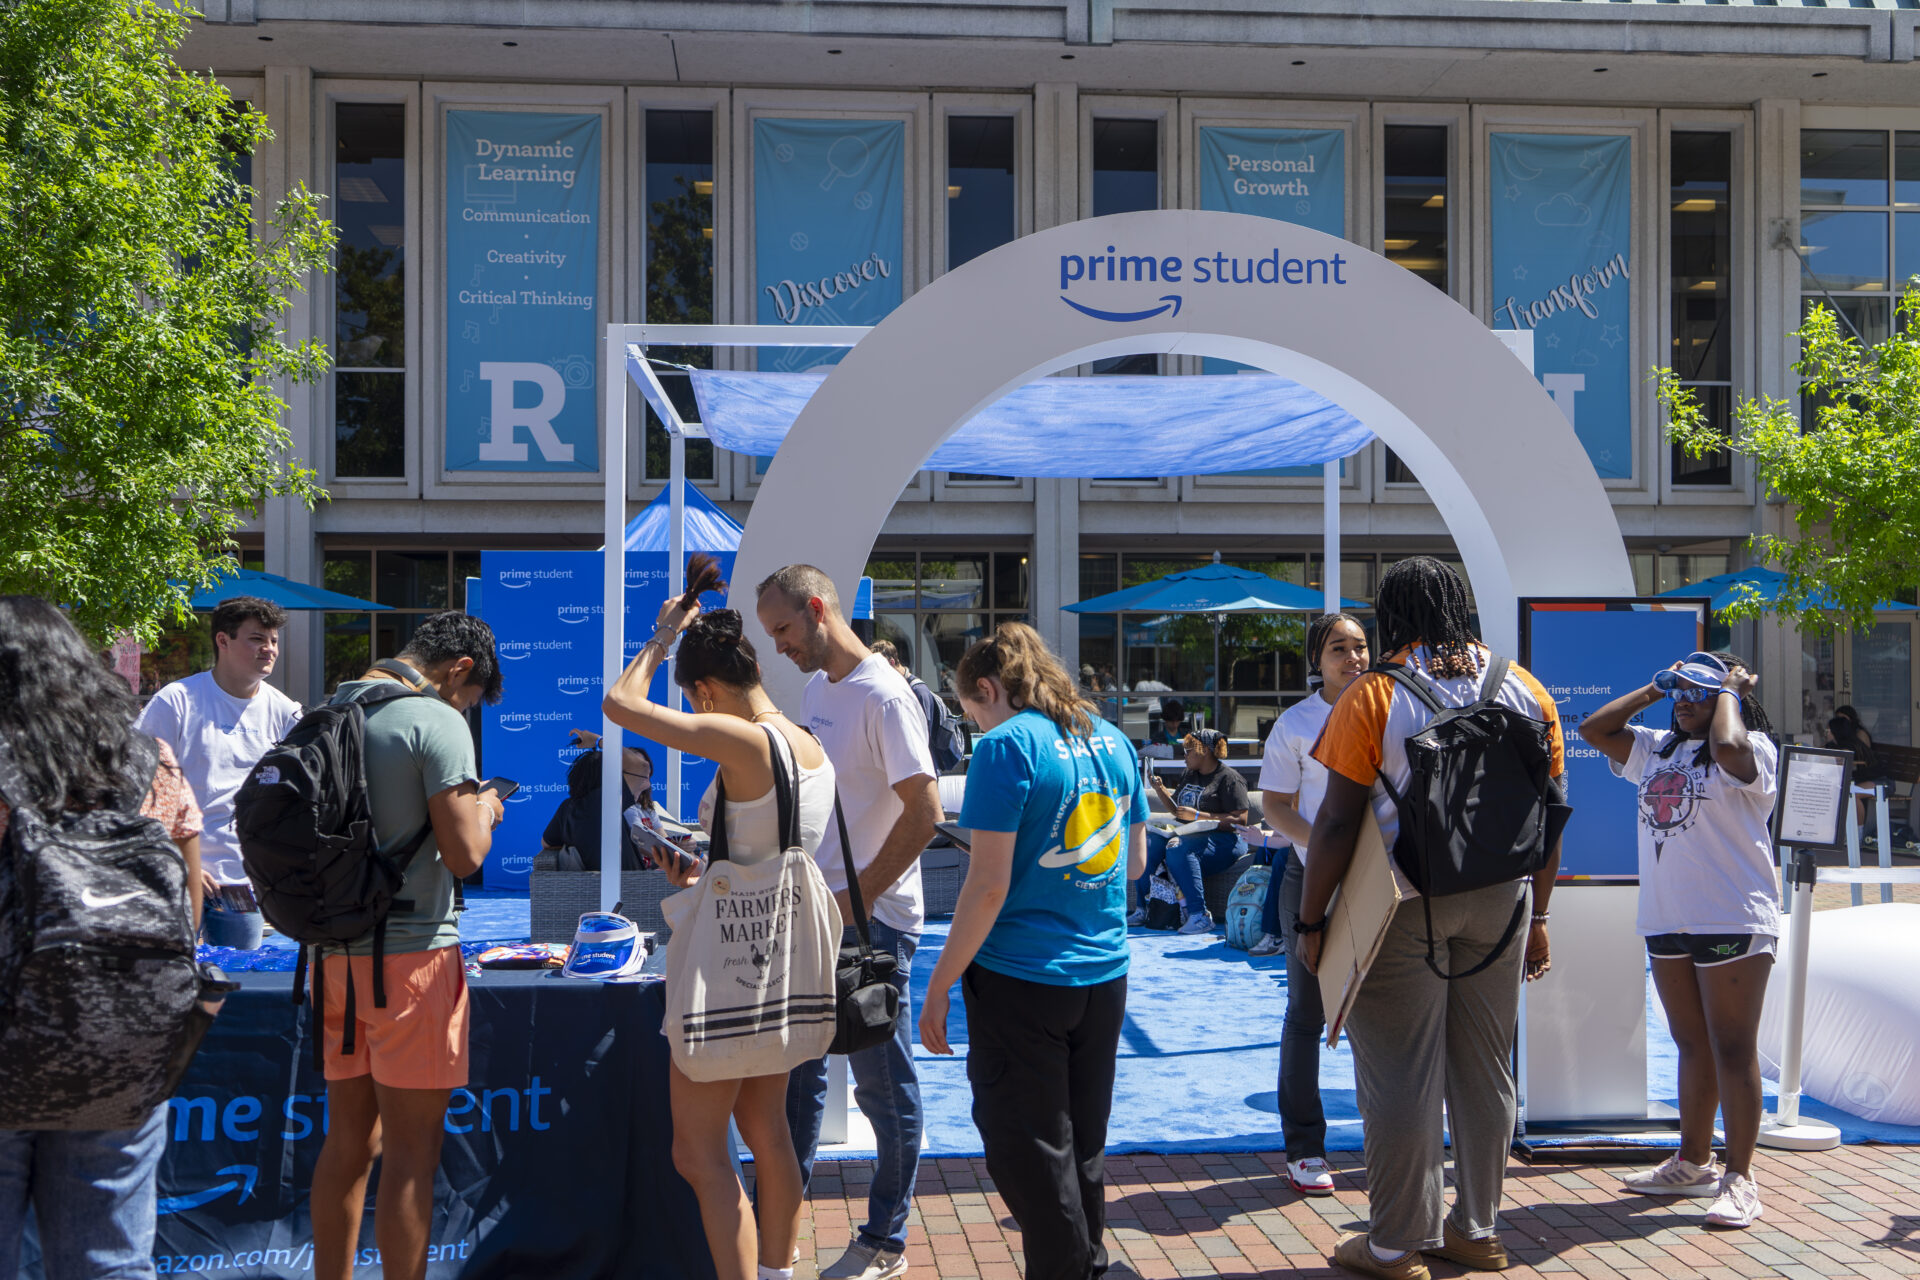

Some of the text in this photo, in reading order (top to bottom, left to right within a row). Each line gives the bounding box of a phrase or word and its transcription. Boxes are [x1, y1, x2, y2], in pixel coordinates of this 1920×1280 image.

[476, 139, 574, 162] Dynamic
[1227, 154, 1315, 173] Personal
[478, 164, 576, 188] Learning
[1234, 178, 1310, 196] Growth
[462, 208, 591, 224] Communication
[487, 249, 567, 268] Creativity
[1060, 245, 1347, 290] prime student
[765, 252, 892, 324] Discover
[1493, 253, 1630, 330] Transform
[459, 290, 593, 310] Critical Thinking
[479, 362, 574, 461] R
[500, 569, 573, 581] prime student
[624, 569, 649, 579] rime
[558, 604, 589, 616] prime
[500, 640, 572, 652] prime student
[558, 675, 589, 687] prime
[1546, 685, 1611, 695] rime student
[500, 711, 572, 723] prime student
[1054, 736, 1116, 760] STAFF
[1566, 746, 1608, 758] deser
[534, 782, 569, 793] studen
[651, 782, 690, 791] stunt
[502, 855, 533, 867] prime
